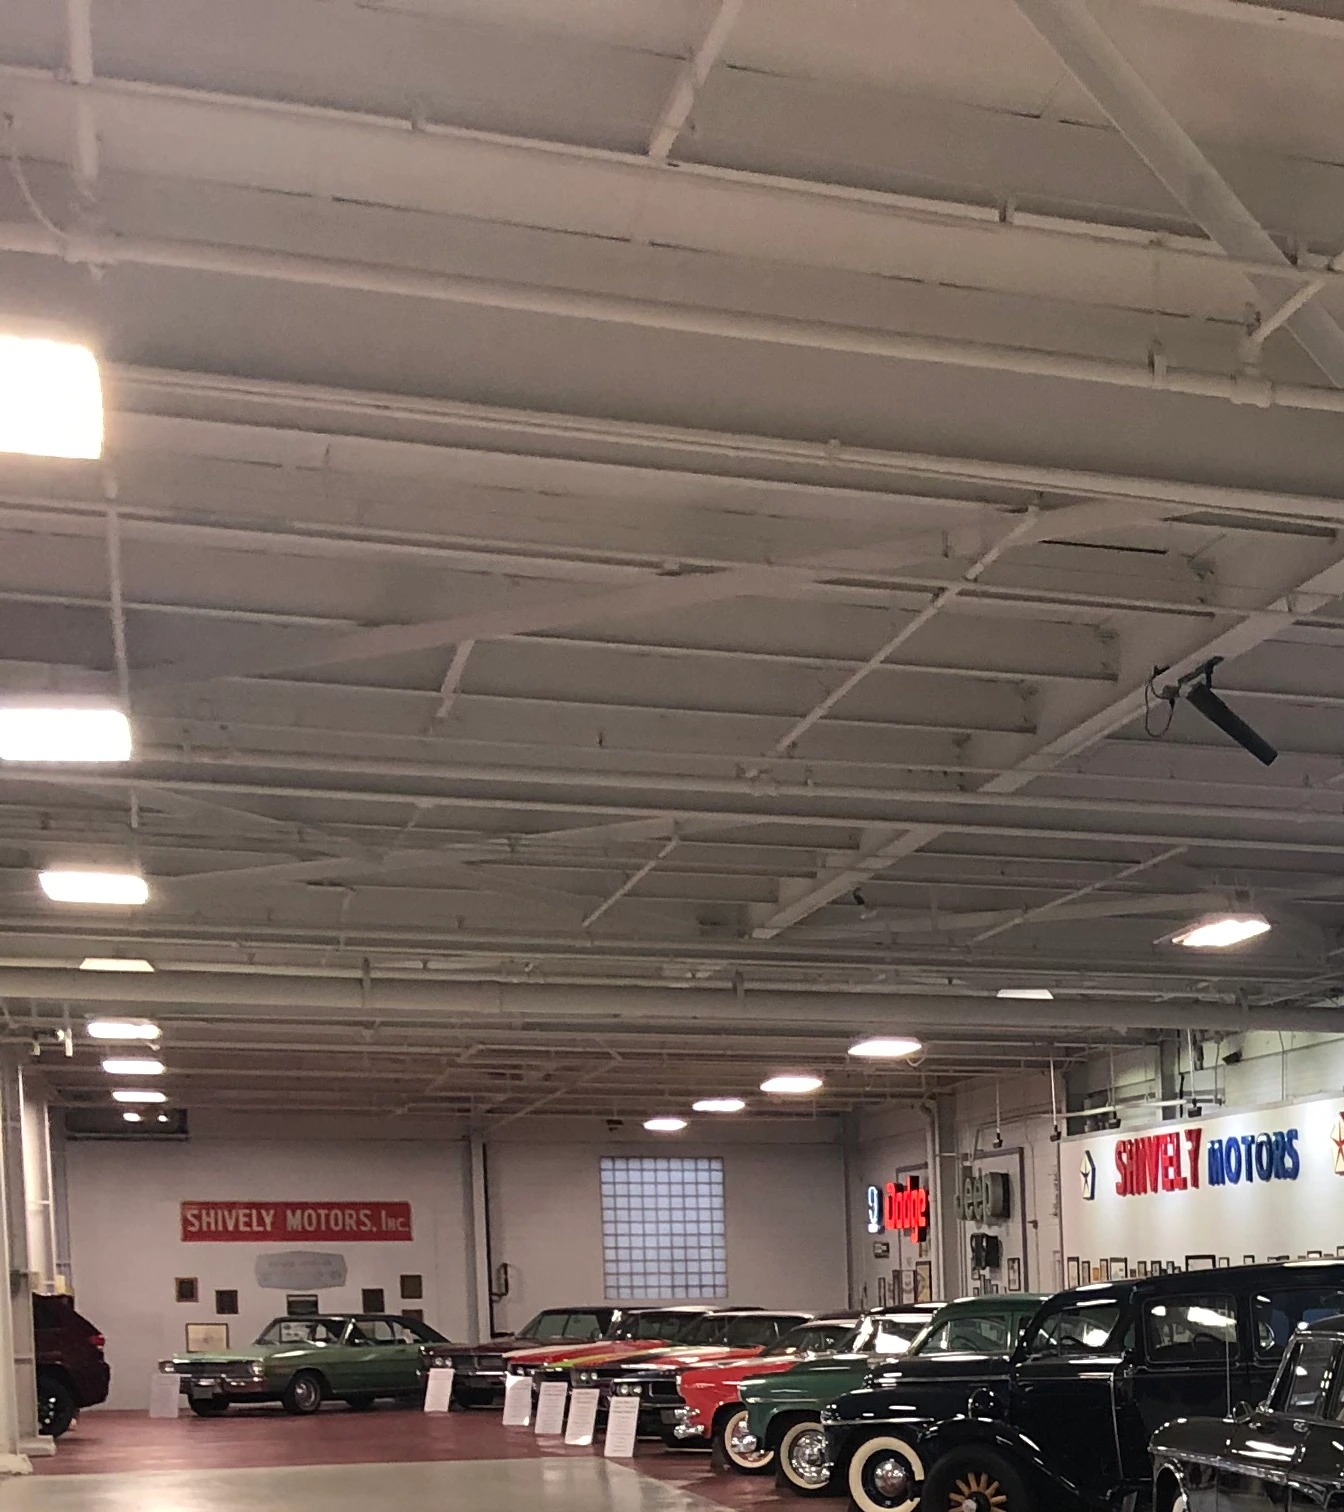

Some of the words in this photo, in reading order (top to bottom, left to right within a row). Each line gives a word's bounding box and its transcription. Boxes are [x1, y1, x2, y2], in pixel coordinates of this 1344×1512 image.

[1115, 1127, 1203, 1197] SHIVELY
[1207, 1127, 1299, 1187] MOTORS
[185, 1208, 275, 1232] SHIVELY
[286, 1208, 377, 1233] MOTORS,
[884, 1175, 928, 1244] Dodge
